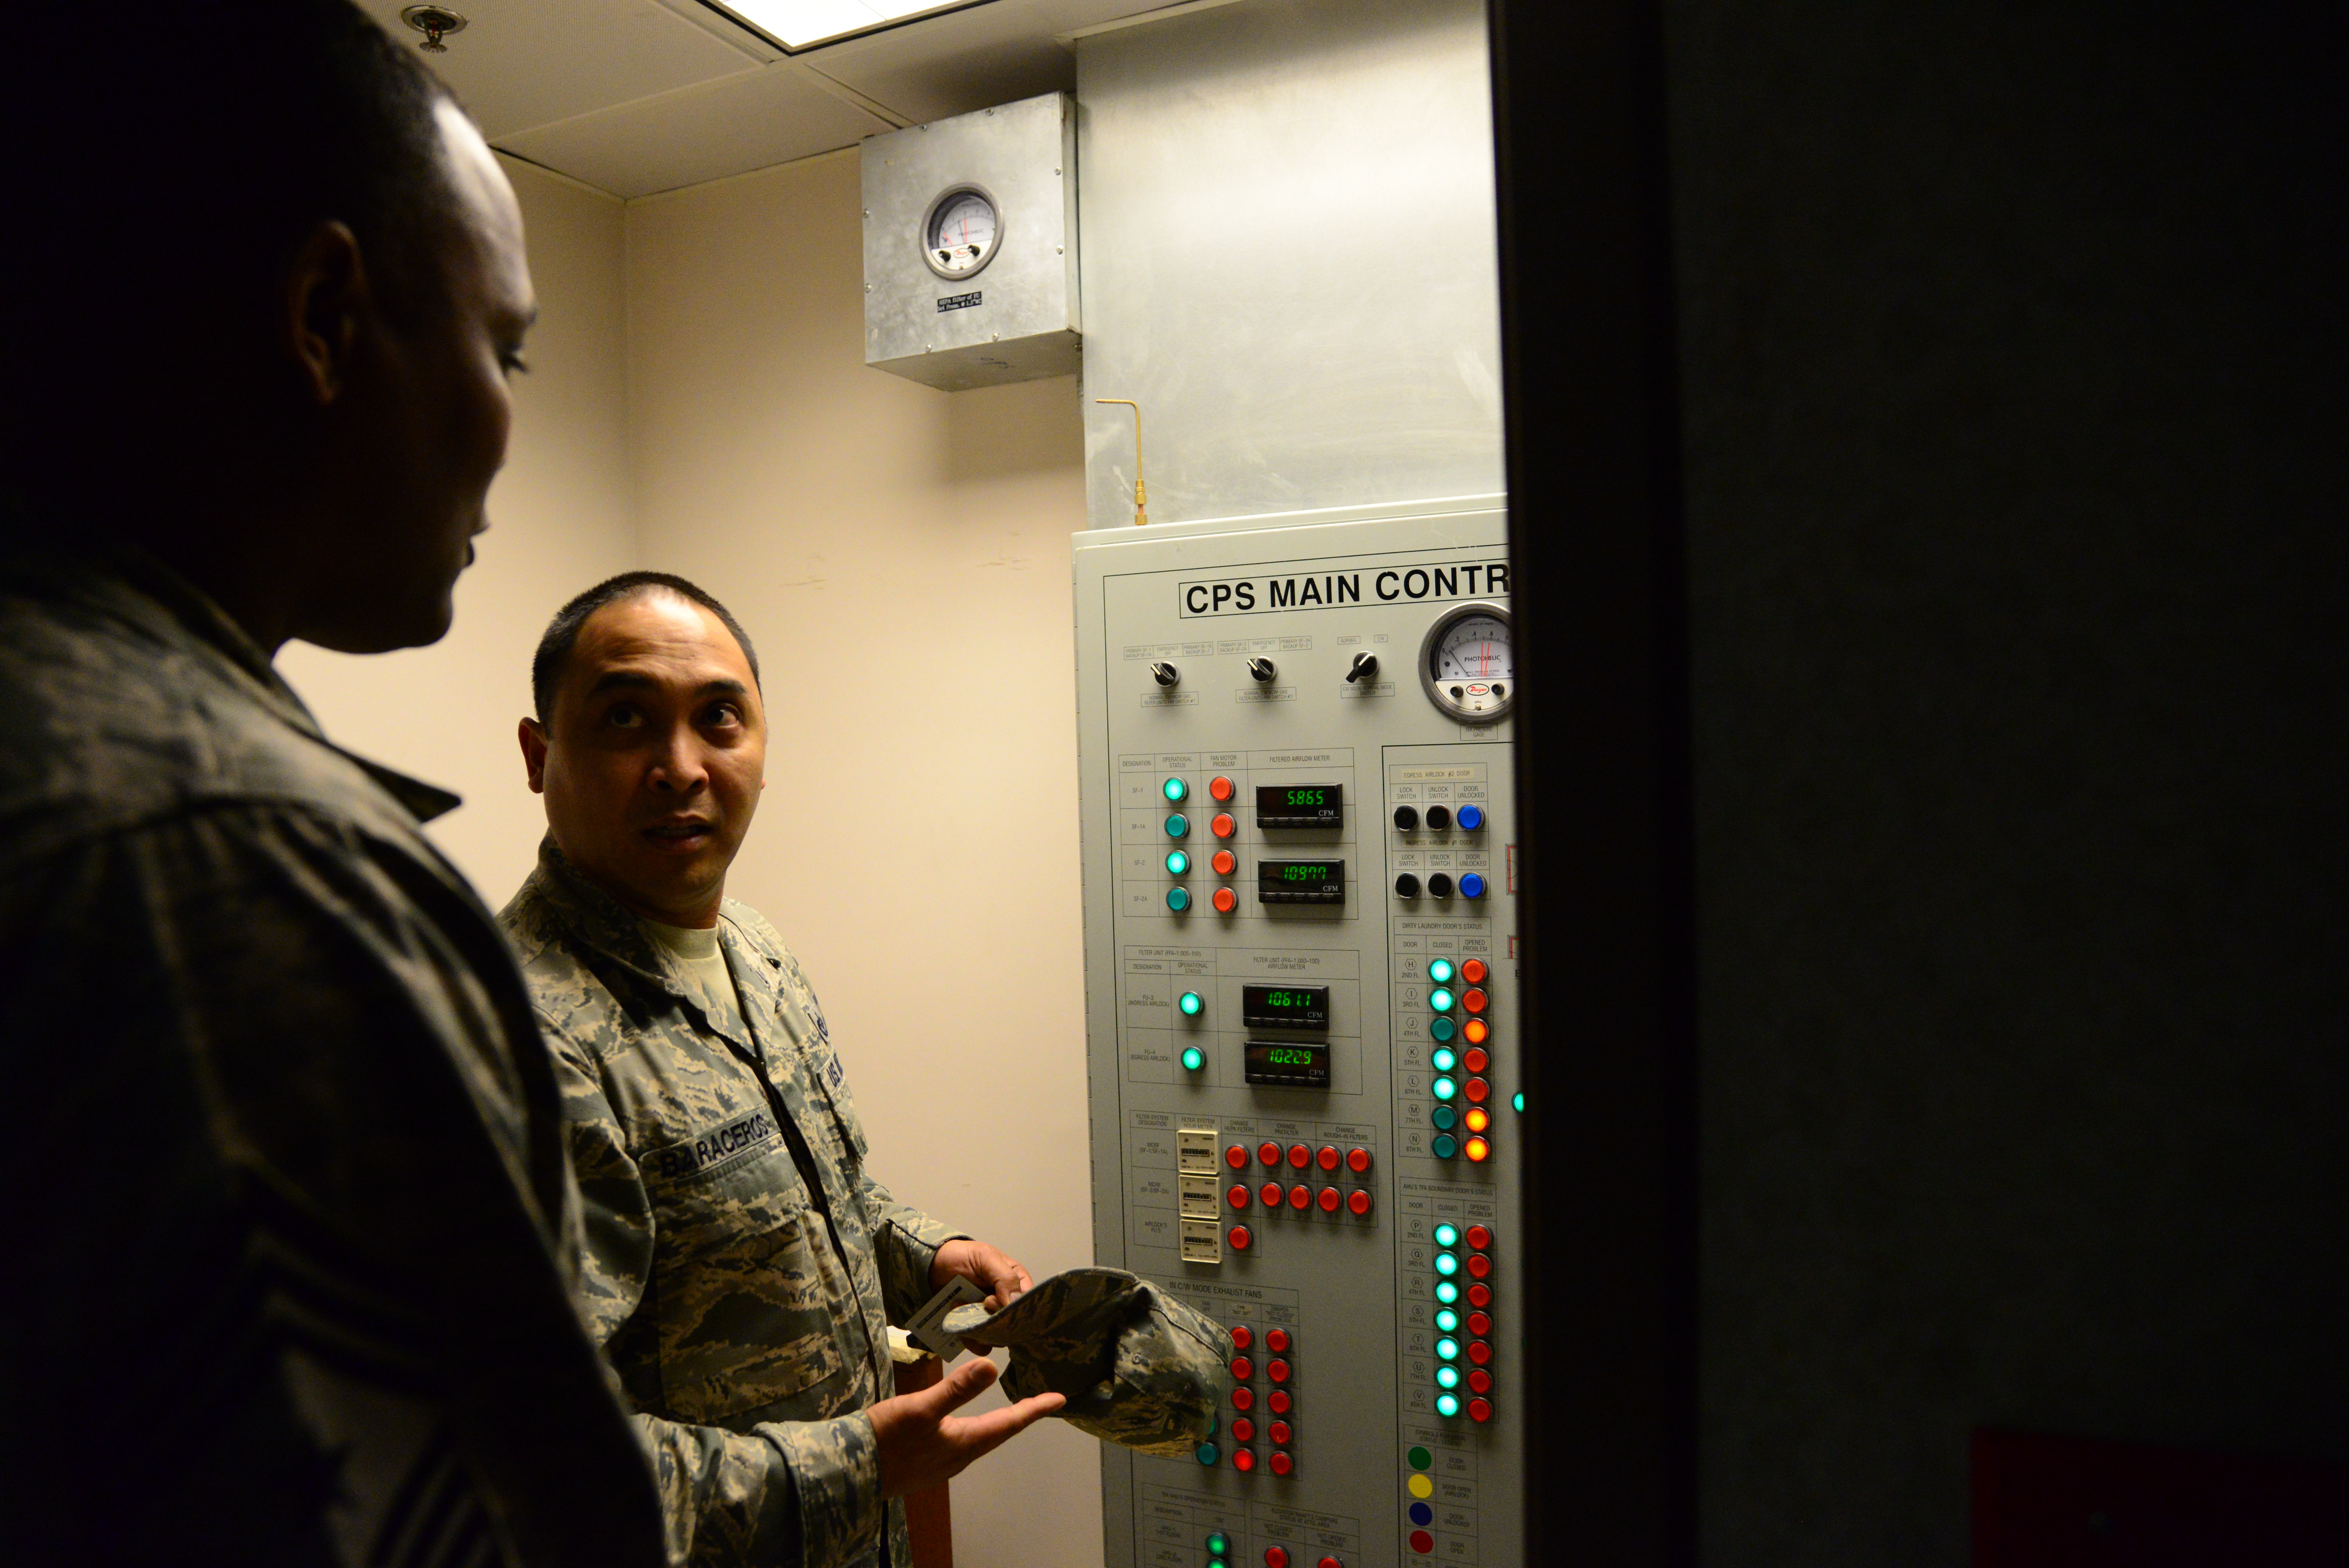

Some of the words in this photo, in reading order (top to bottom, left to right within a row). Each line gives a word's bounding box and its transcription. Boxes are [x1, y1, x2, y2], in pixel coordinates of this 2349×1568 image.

[1186, 582, 1255, 614] CPS
[1270, 574, 1360, 608] MAIN
[1287, 790, 1324, 805] 5865
[1285, 866, 1326, 880] 10977
[660, 1114, 768, 1177] BARACEROS
[1468, 1210, 1492, 1218] PROBLEM
[1178, 1282, 1191, 1291] C/W
[1192, 1284, 1211, 1293] MODE
[1213, 1285, 1243, 1297] EXHAUST
[1245, 1290, 1262, 1299] FANS
[1447, 1463, 1466, 1471] CLOSED
